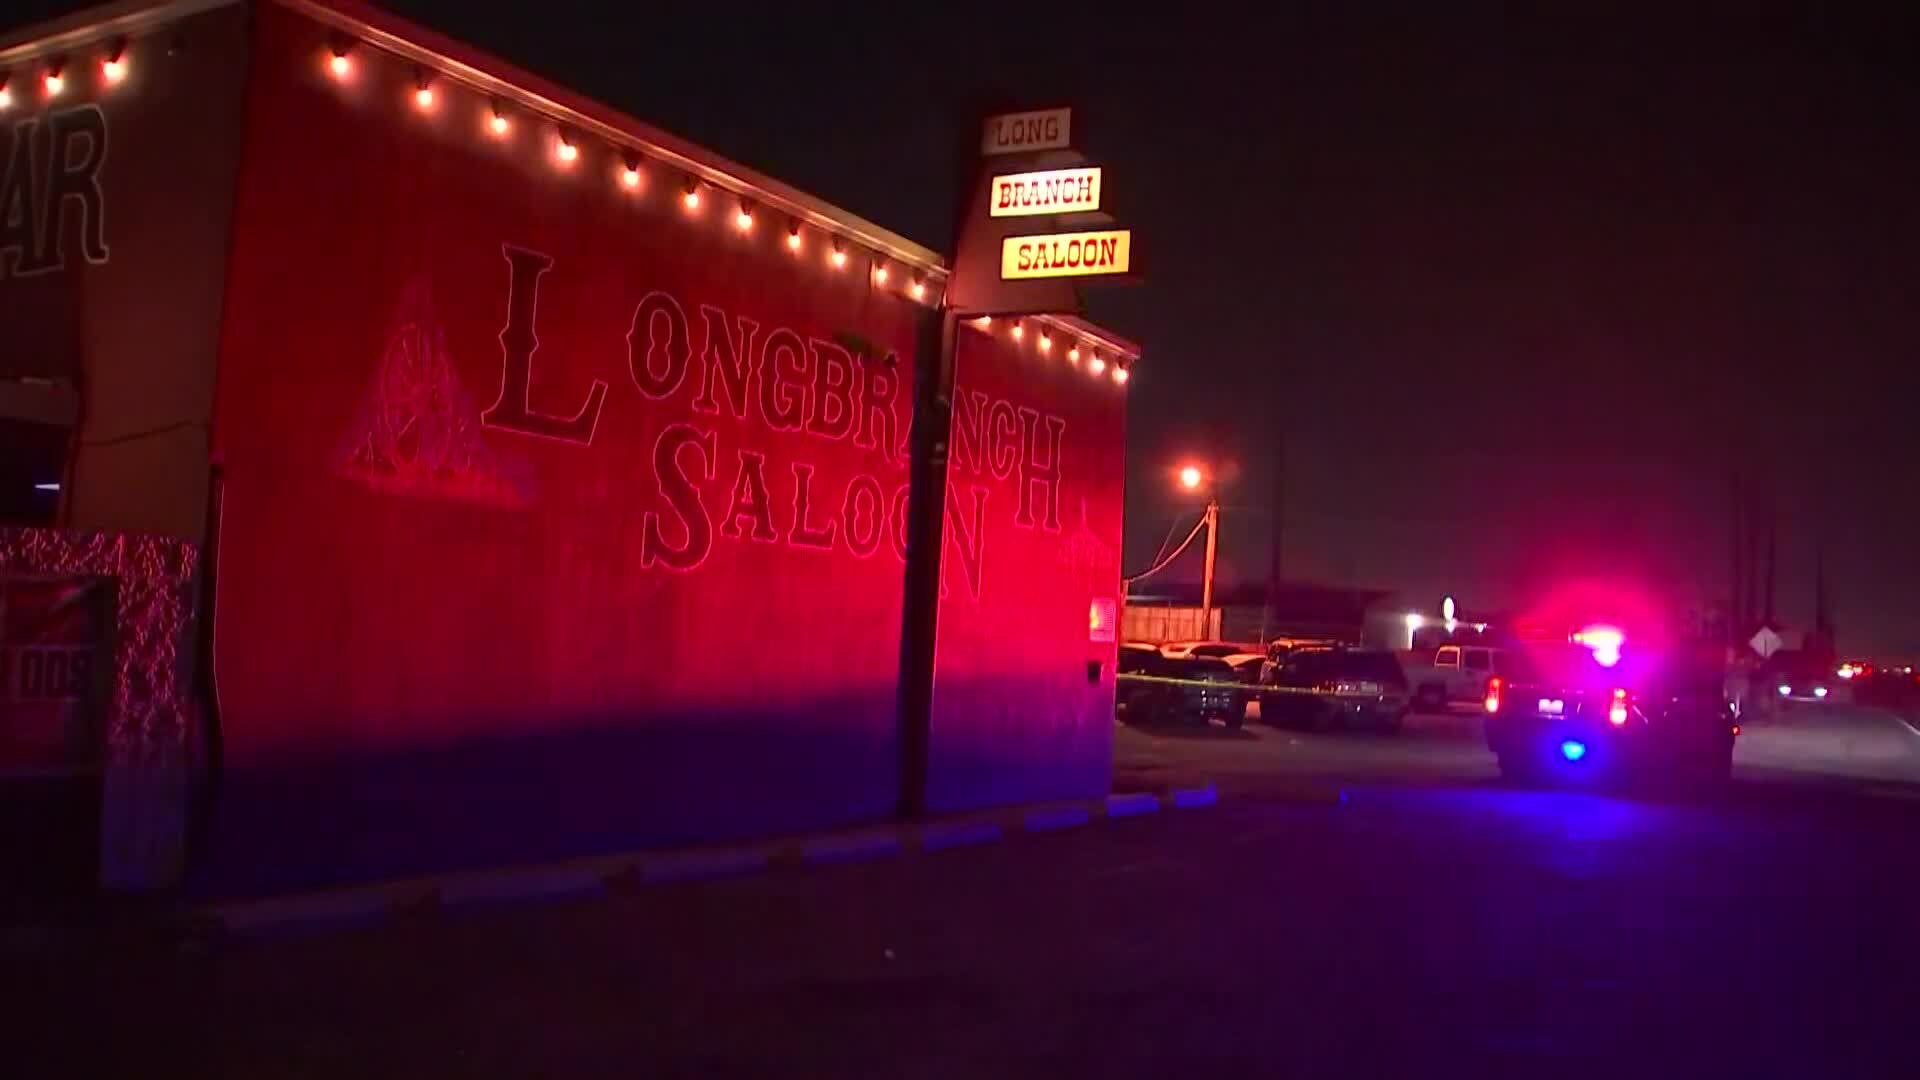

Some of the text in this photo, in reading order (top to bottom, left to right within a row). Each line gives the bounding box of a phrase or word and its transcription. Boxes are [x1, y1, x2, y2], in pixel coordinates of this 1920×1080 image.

[997, 117, 1059, 146] LONG
[999, 175, 1093, 209] BRANCH
[1017, 238, 1117, 271] SALOON
[481, 243, 1066, 534] LONGBRNCH
